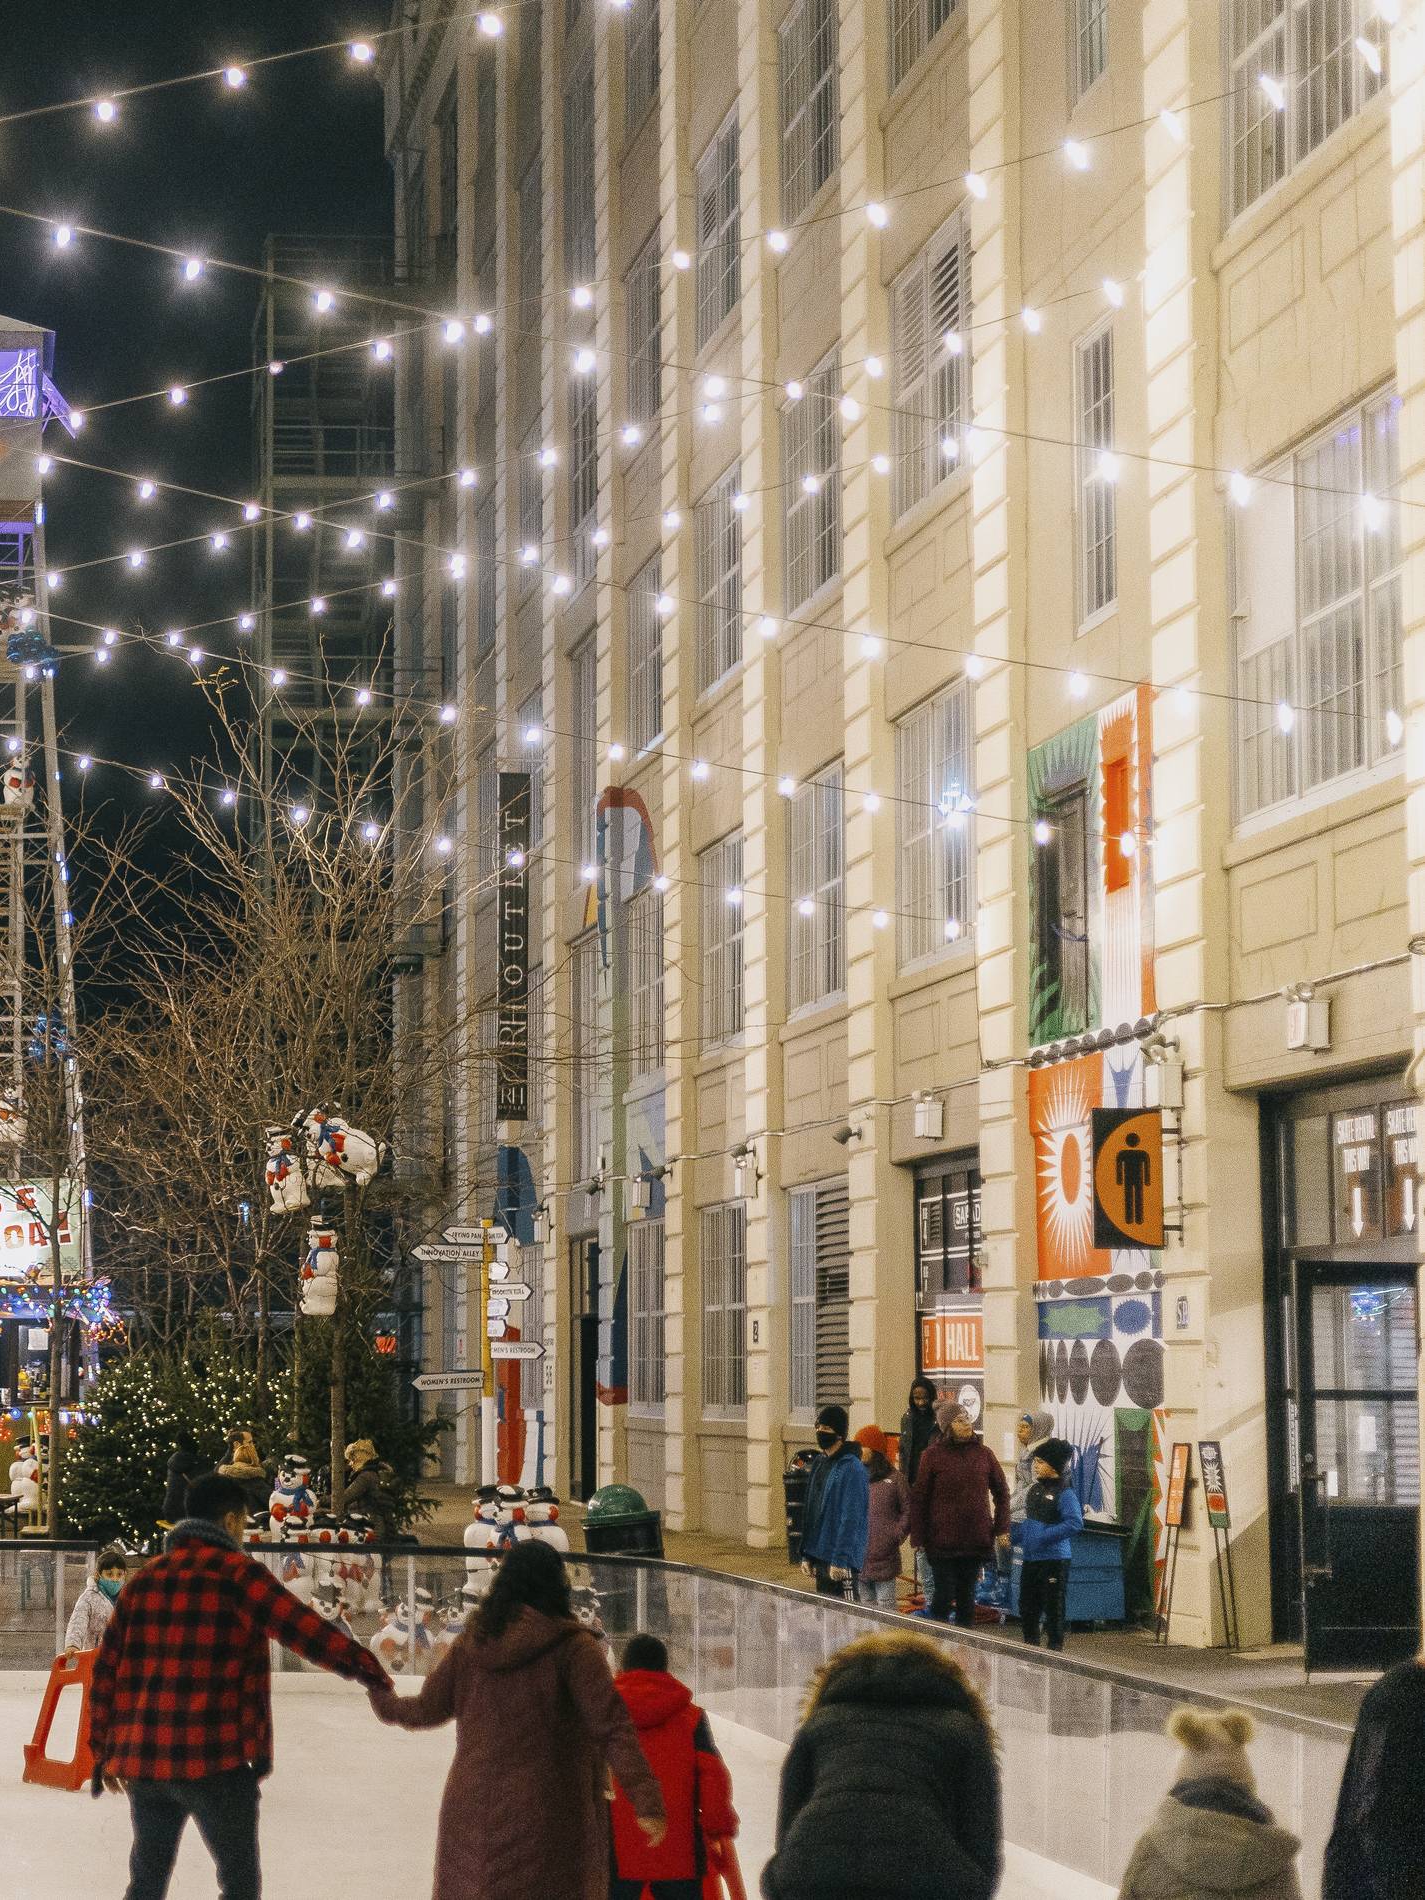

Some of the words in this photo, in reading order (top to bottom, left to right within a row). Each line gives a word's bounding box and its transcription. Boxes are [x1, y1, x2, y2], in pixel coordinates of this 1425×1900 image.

[504, 809, 525, 986] OUTLET
[501, 1086, 524, 1105] RH
[16, 1187, 37, 1211] &
[421, 1247, 461, 1257] INNOVATION
[462, 1248, 480, 1257] ALLEY
[510, 1346, 536, 1354] RESTROOM
[945, 1322, 980, 1361] HALL
[421, 1378, 449, 1386] WOMEN'S
[450, 1376, 481, 1385] RESTROOM
